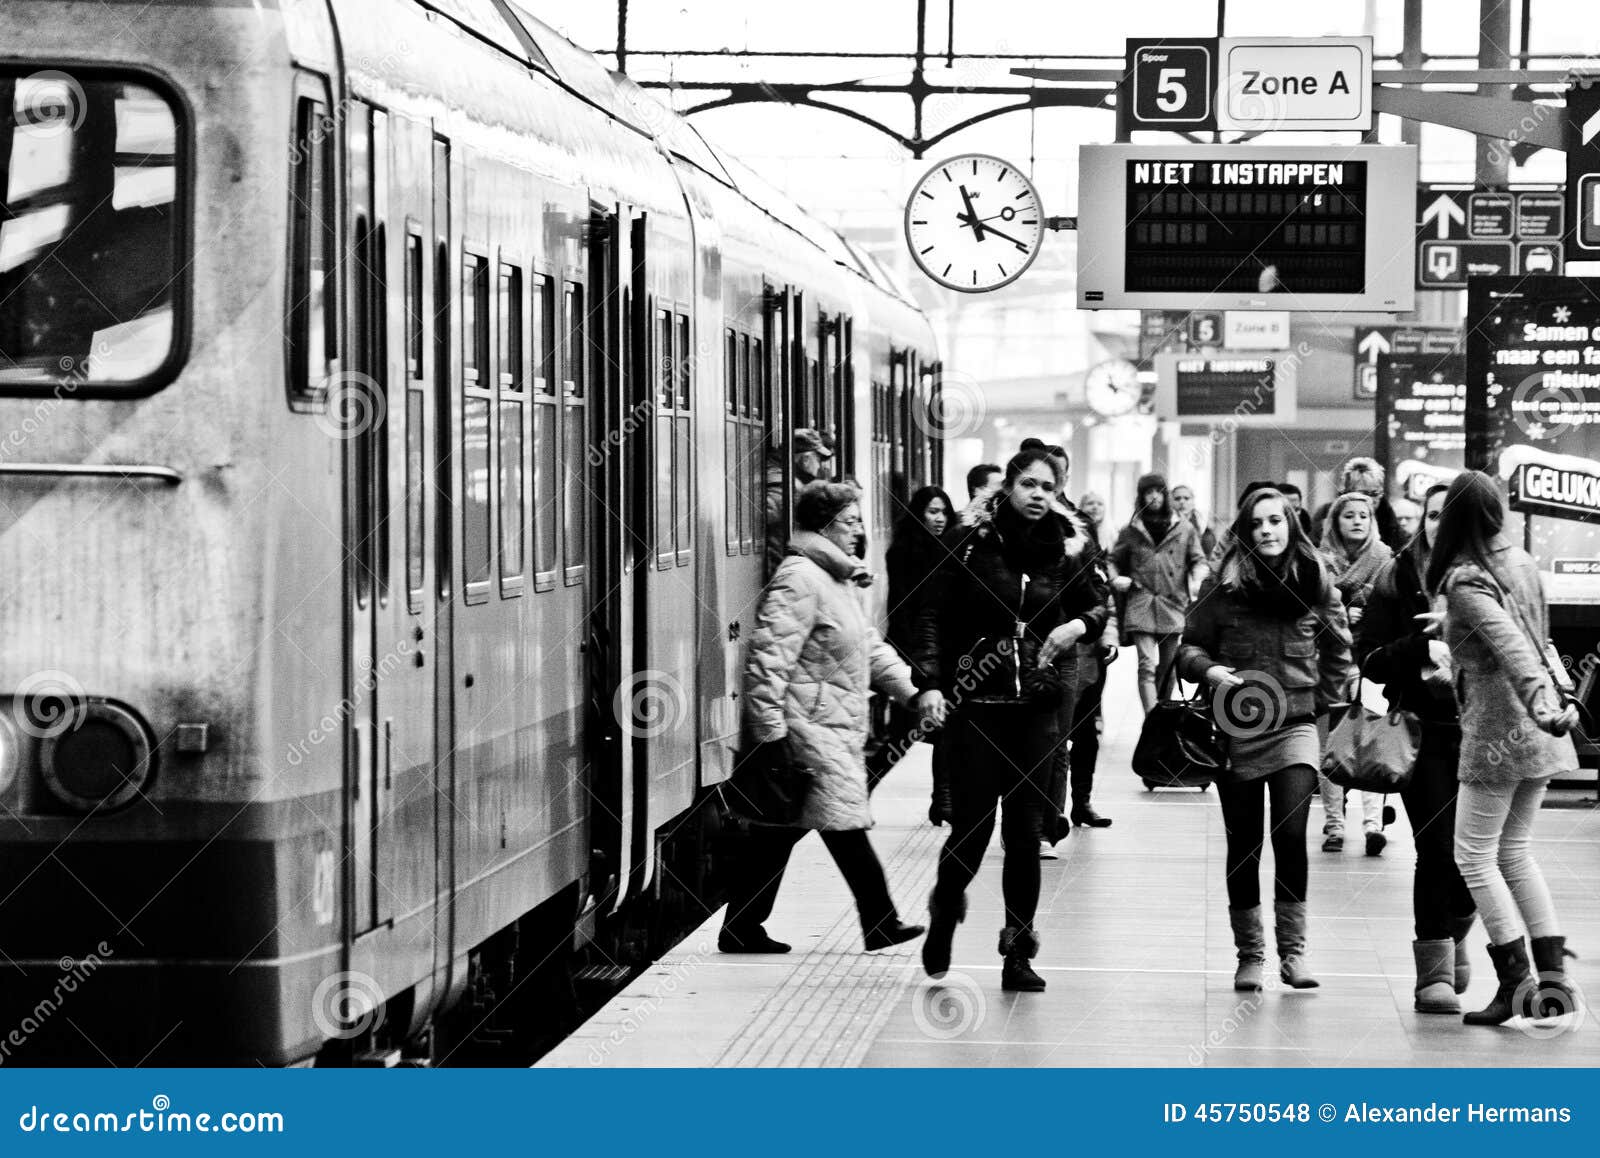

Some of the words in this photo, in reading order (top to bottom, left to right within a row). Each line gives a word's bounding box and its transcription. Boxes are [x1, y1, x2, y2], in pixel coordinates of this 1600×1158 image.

[1142, 53, 1168, 63] Spoor
[1156, 68, 1188, 112] 5
[1240, 71, 1318, 96] Zone
[1328, 70, 1350, 95] A
[1135, 163, 1194, 184] NIET
[1212, 163, 1344, 185] INSTAPPEN
[1199, 320, 1213, 341] 5
[1523, 323, 1589, 341] Samen
[1497, 350, 1540, 365] naar
[1542, 350, 1580, 365] een
